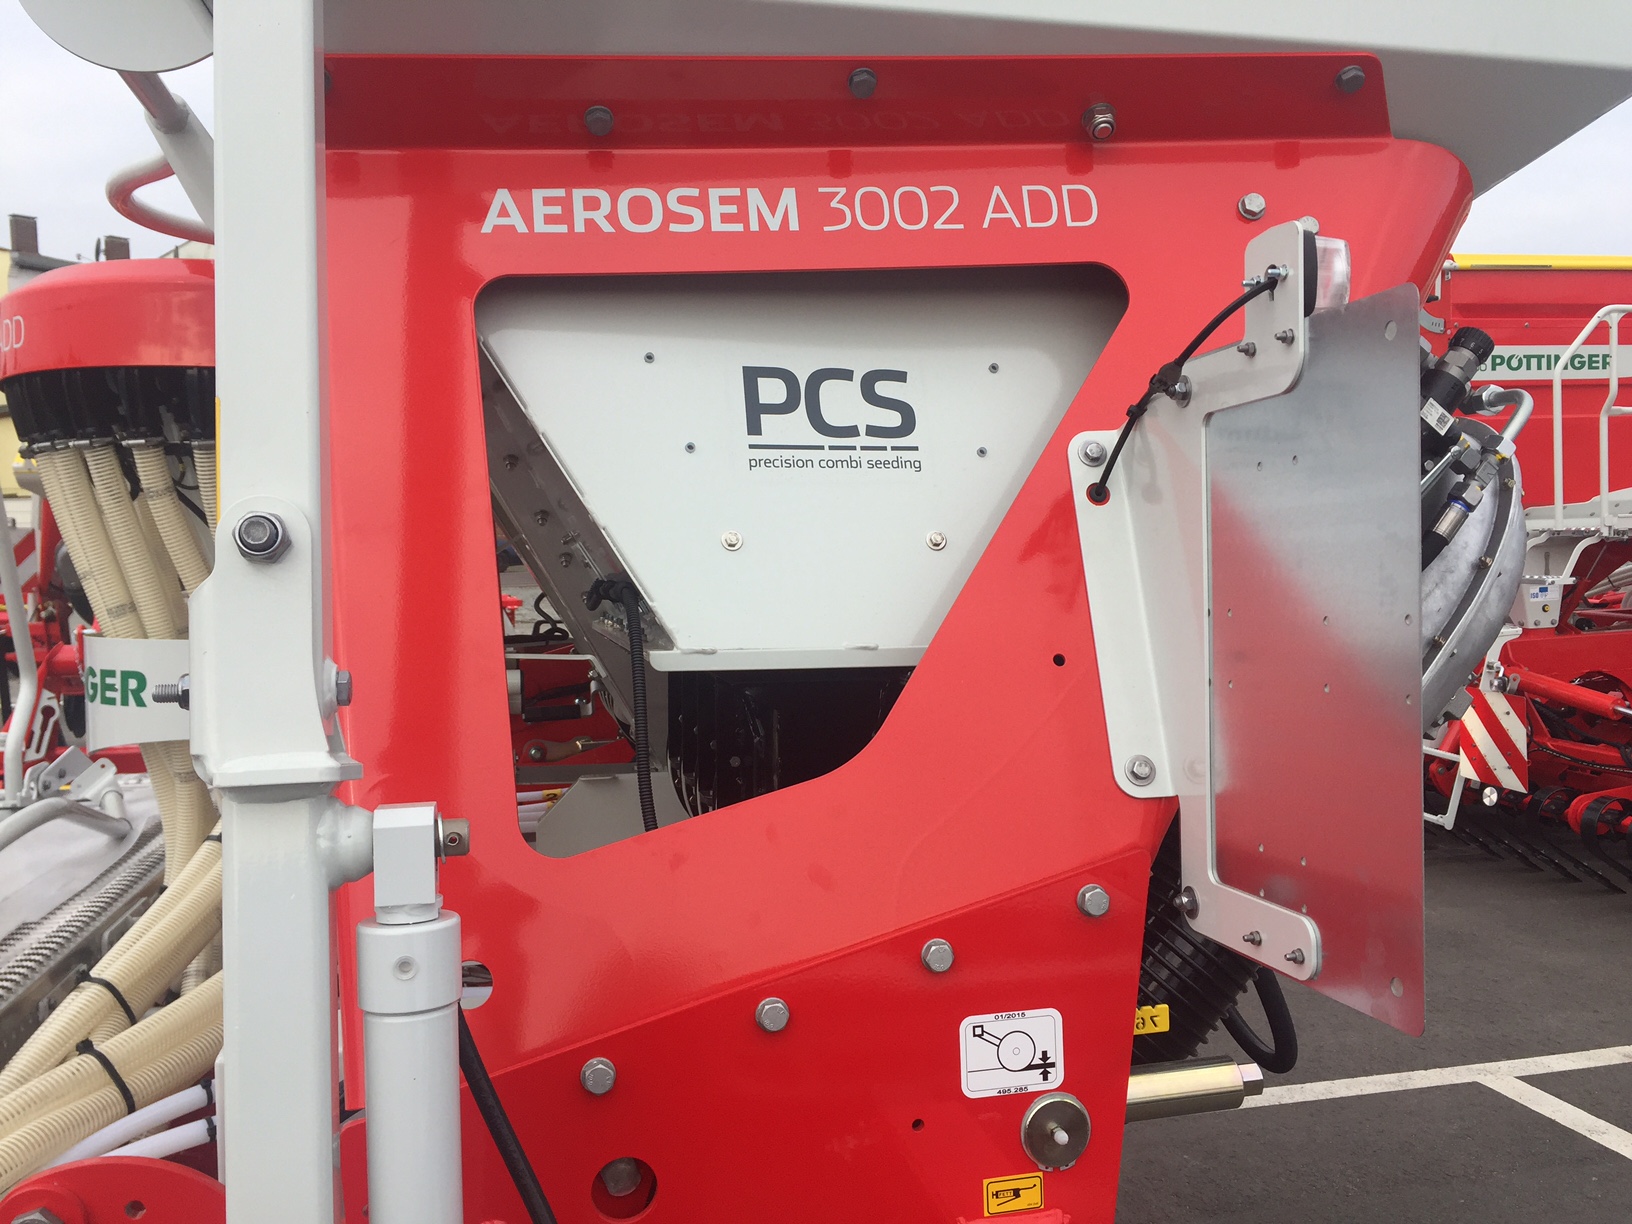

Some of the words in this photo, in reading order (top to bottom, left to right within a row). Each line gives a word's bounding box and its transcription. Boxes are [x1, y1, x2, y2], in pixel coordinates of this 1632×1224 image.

[480, 187, 800, 233] AEROSEM
[817, 186, 965, 231] 3002
[982, 184, 1099, 229] ADD
[0, 315, 25, 352] DD
[742, 366, 917, 439] PCS
[748, 455, 814, 471] precision
[818, 455, 862, 469] combi
[866, 456, 922, 472] seeding
[993, 1011, 1026, 1020] 01/2015
